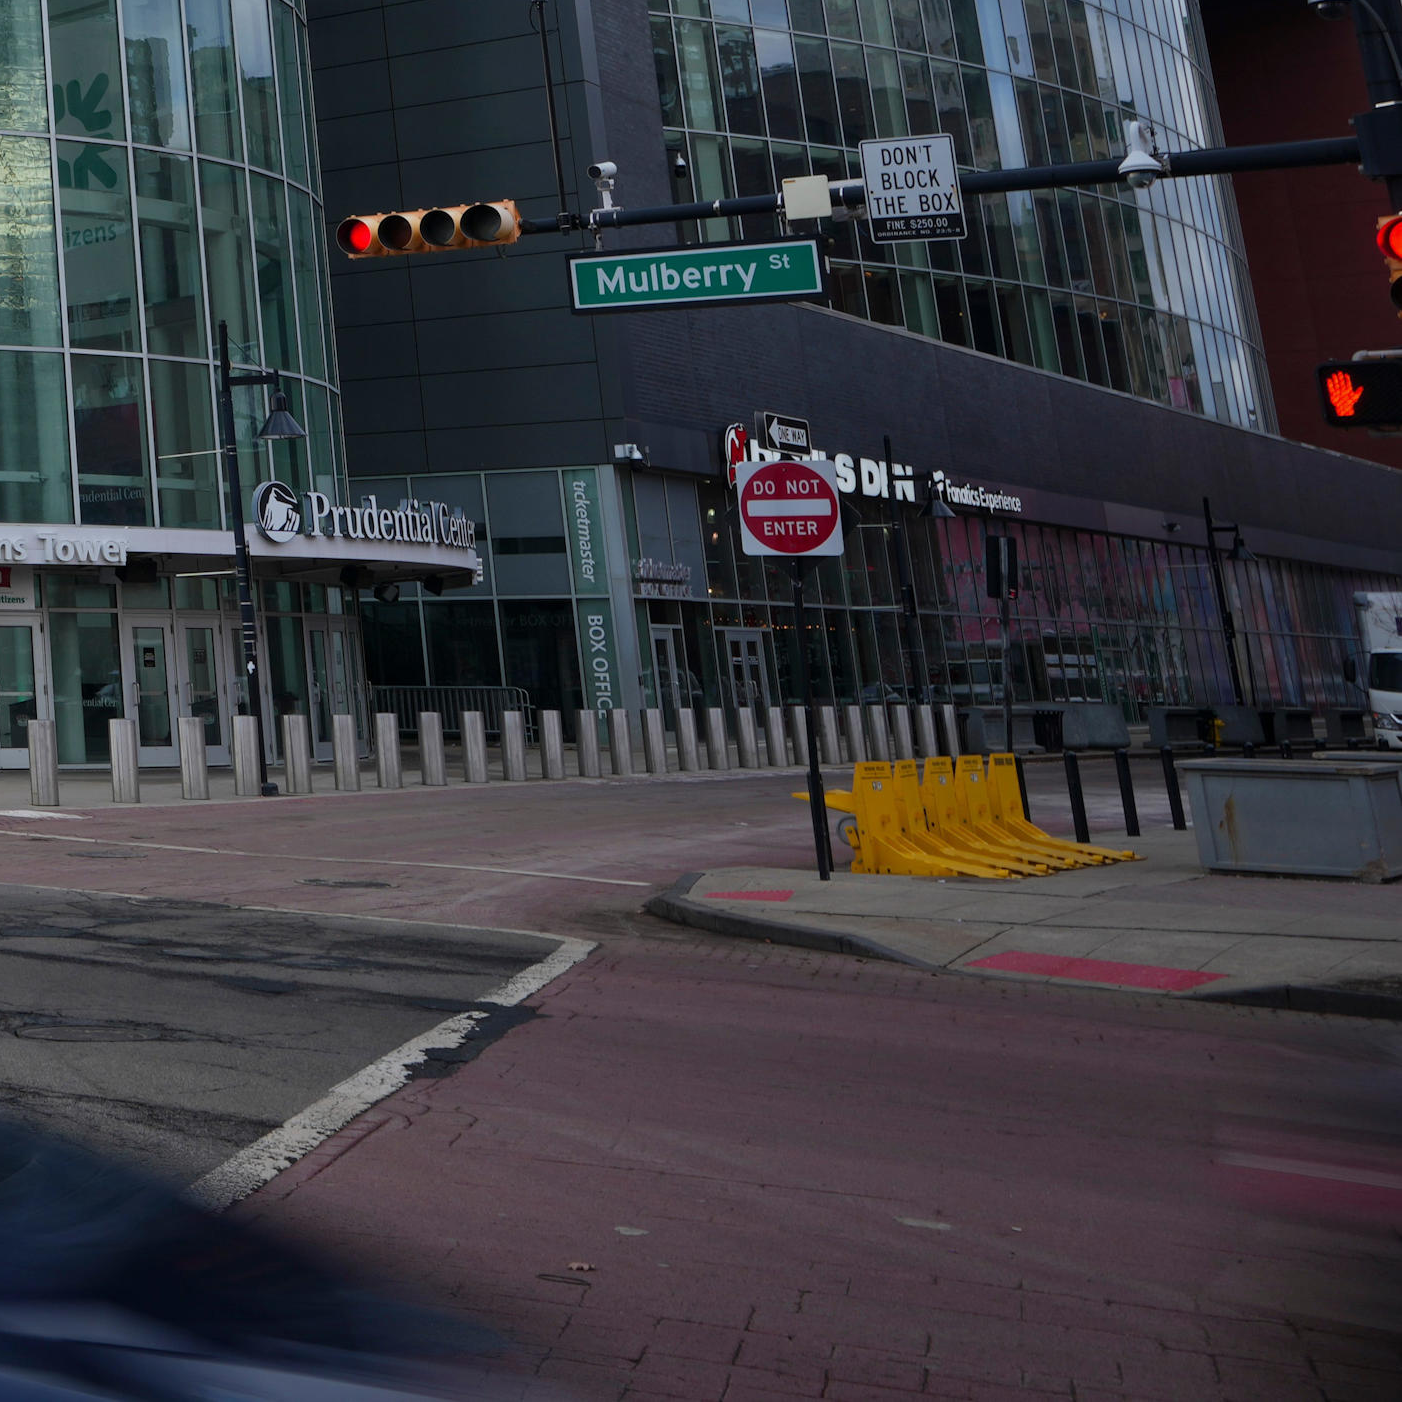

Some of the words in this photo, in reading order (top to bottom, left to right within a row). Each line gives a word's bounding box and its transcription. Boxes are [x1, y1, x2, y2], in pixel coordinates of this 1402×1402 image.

[881, 145, 932, 167] DON'T
[881, 169, 941, 191] BLOCK
[873, 196, 909, 216] THE
[919, 192, 956, 213] BOX
[65, 222, 118, 249] izens
[886, 220, 906, 231] FINE
[910, 217, 949, 230] $250.00
[597, 261, 757, 296] Mulberry
[769, 253, 791, 270] St
[778, 426, 791, 442] ONE
[791, 429, 806, 445] WAY
[80, 486, 123, 503] udential
[753, 479, 776, 496] DO
[786, 479, 820, 495] NOT
[945, 478, 981, 507] Fanatics
[978, 486, 1022, 515] Experience
[307, 491, 439, 544] Prudential
[439, 501, 477, 550] Center
[572, 479, 596, 584] ticketmaster
[763, 520, 819, 537] ENTER
[37, 532, 128, 563] Tower
[588, 614, 608, 654] BOX
[592, 656, 614, 721] OFFICE
